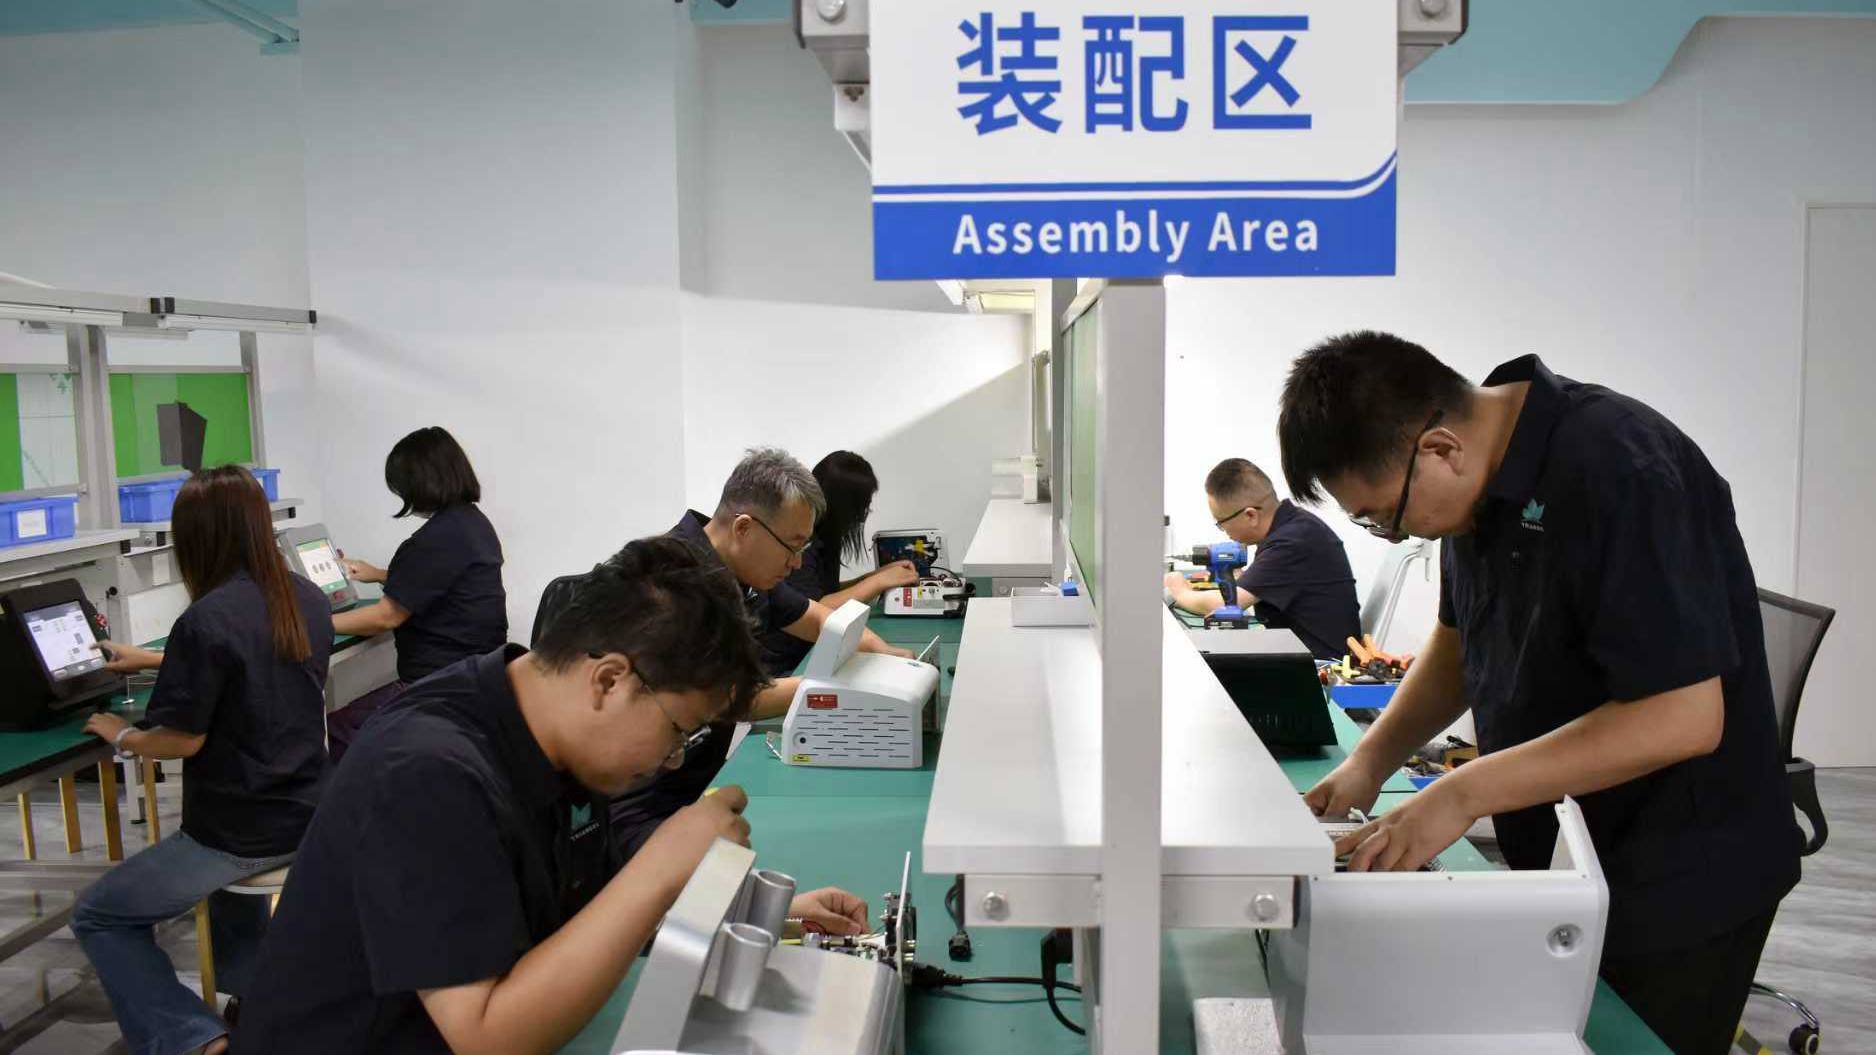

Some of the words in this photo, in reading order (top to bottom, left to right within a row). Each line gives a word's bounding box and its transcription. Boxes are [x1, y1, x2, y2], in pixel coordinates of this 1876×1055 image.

[957, 12, 1312, 135] 装配区
[952, 209, 1191, 263] Assembly
[1207, 211, 1319, 252] Area
